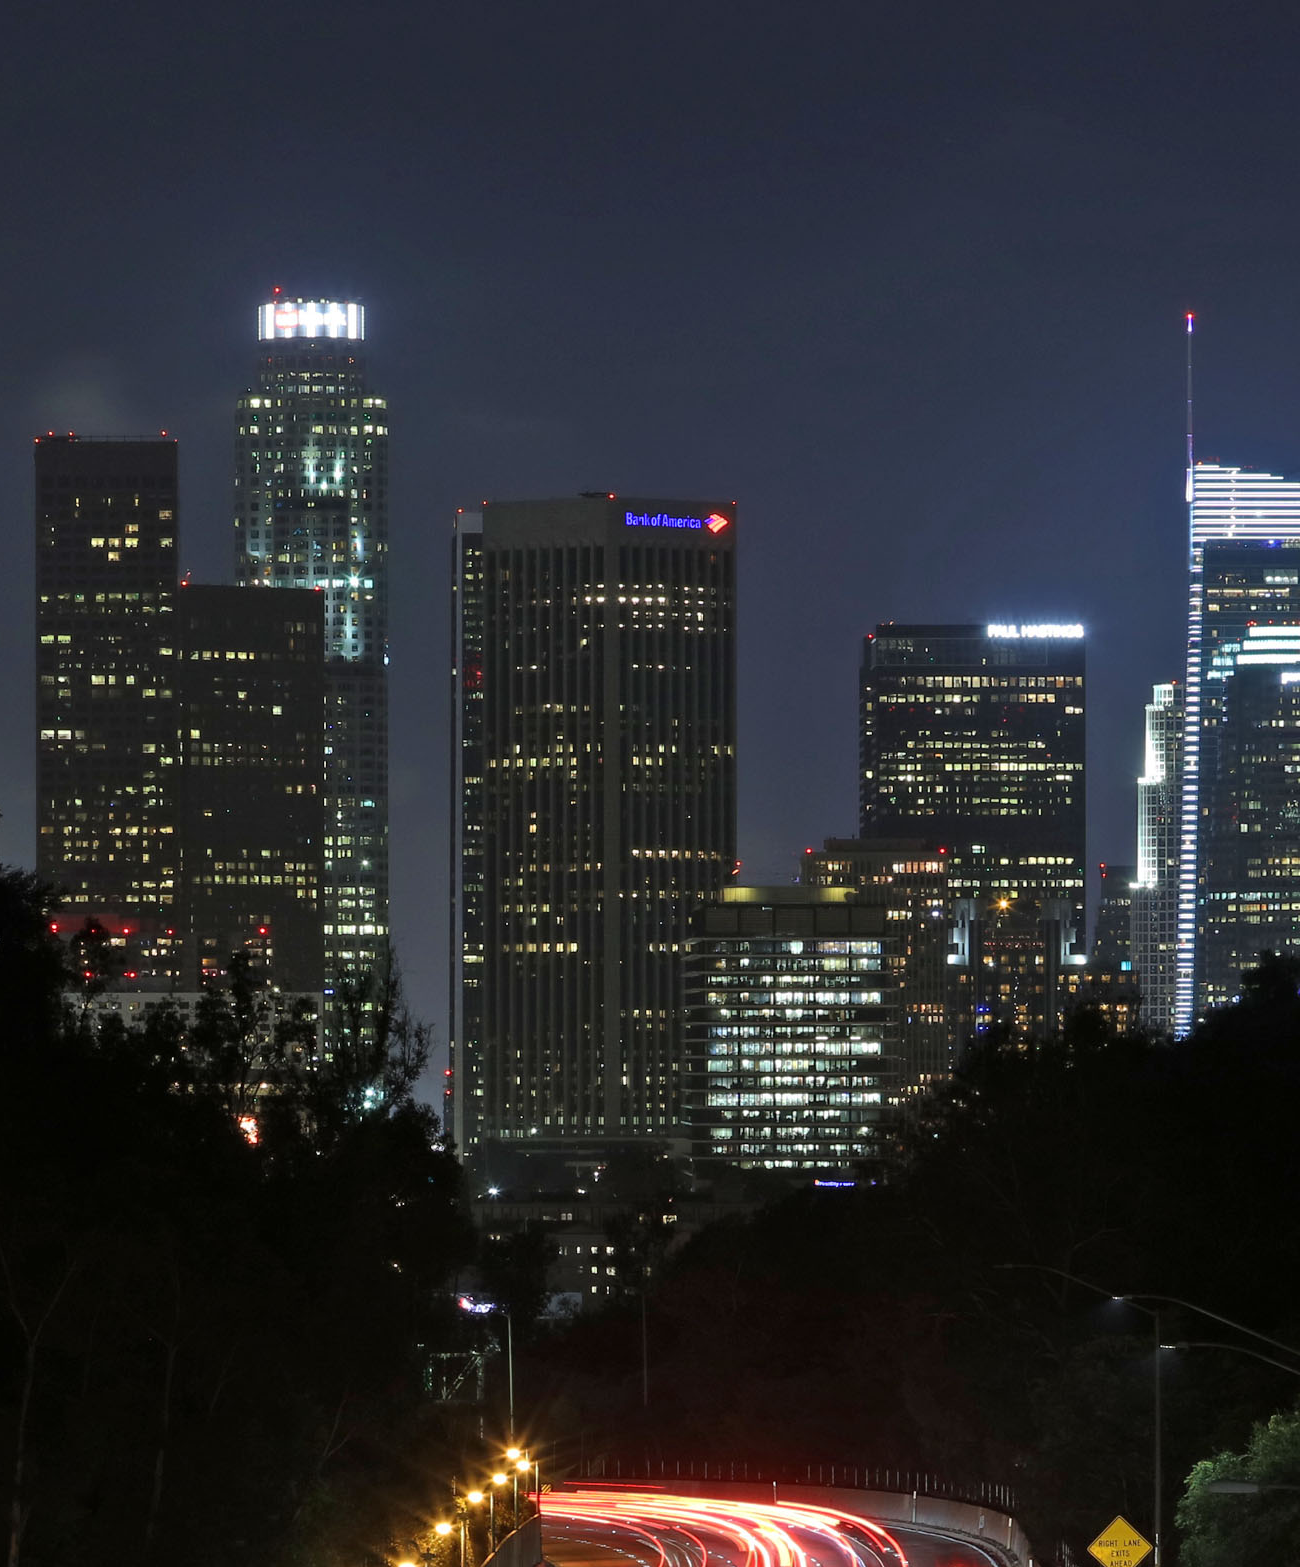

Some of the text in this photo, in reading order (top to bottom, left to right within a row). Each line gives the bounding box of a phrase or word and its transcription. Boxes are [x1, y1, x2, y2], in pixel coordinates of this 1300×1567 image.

[625, 512, 702, 529] Bank of America
